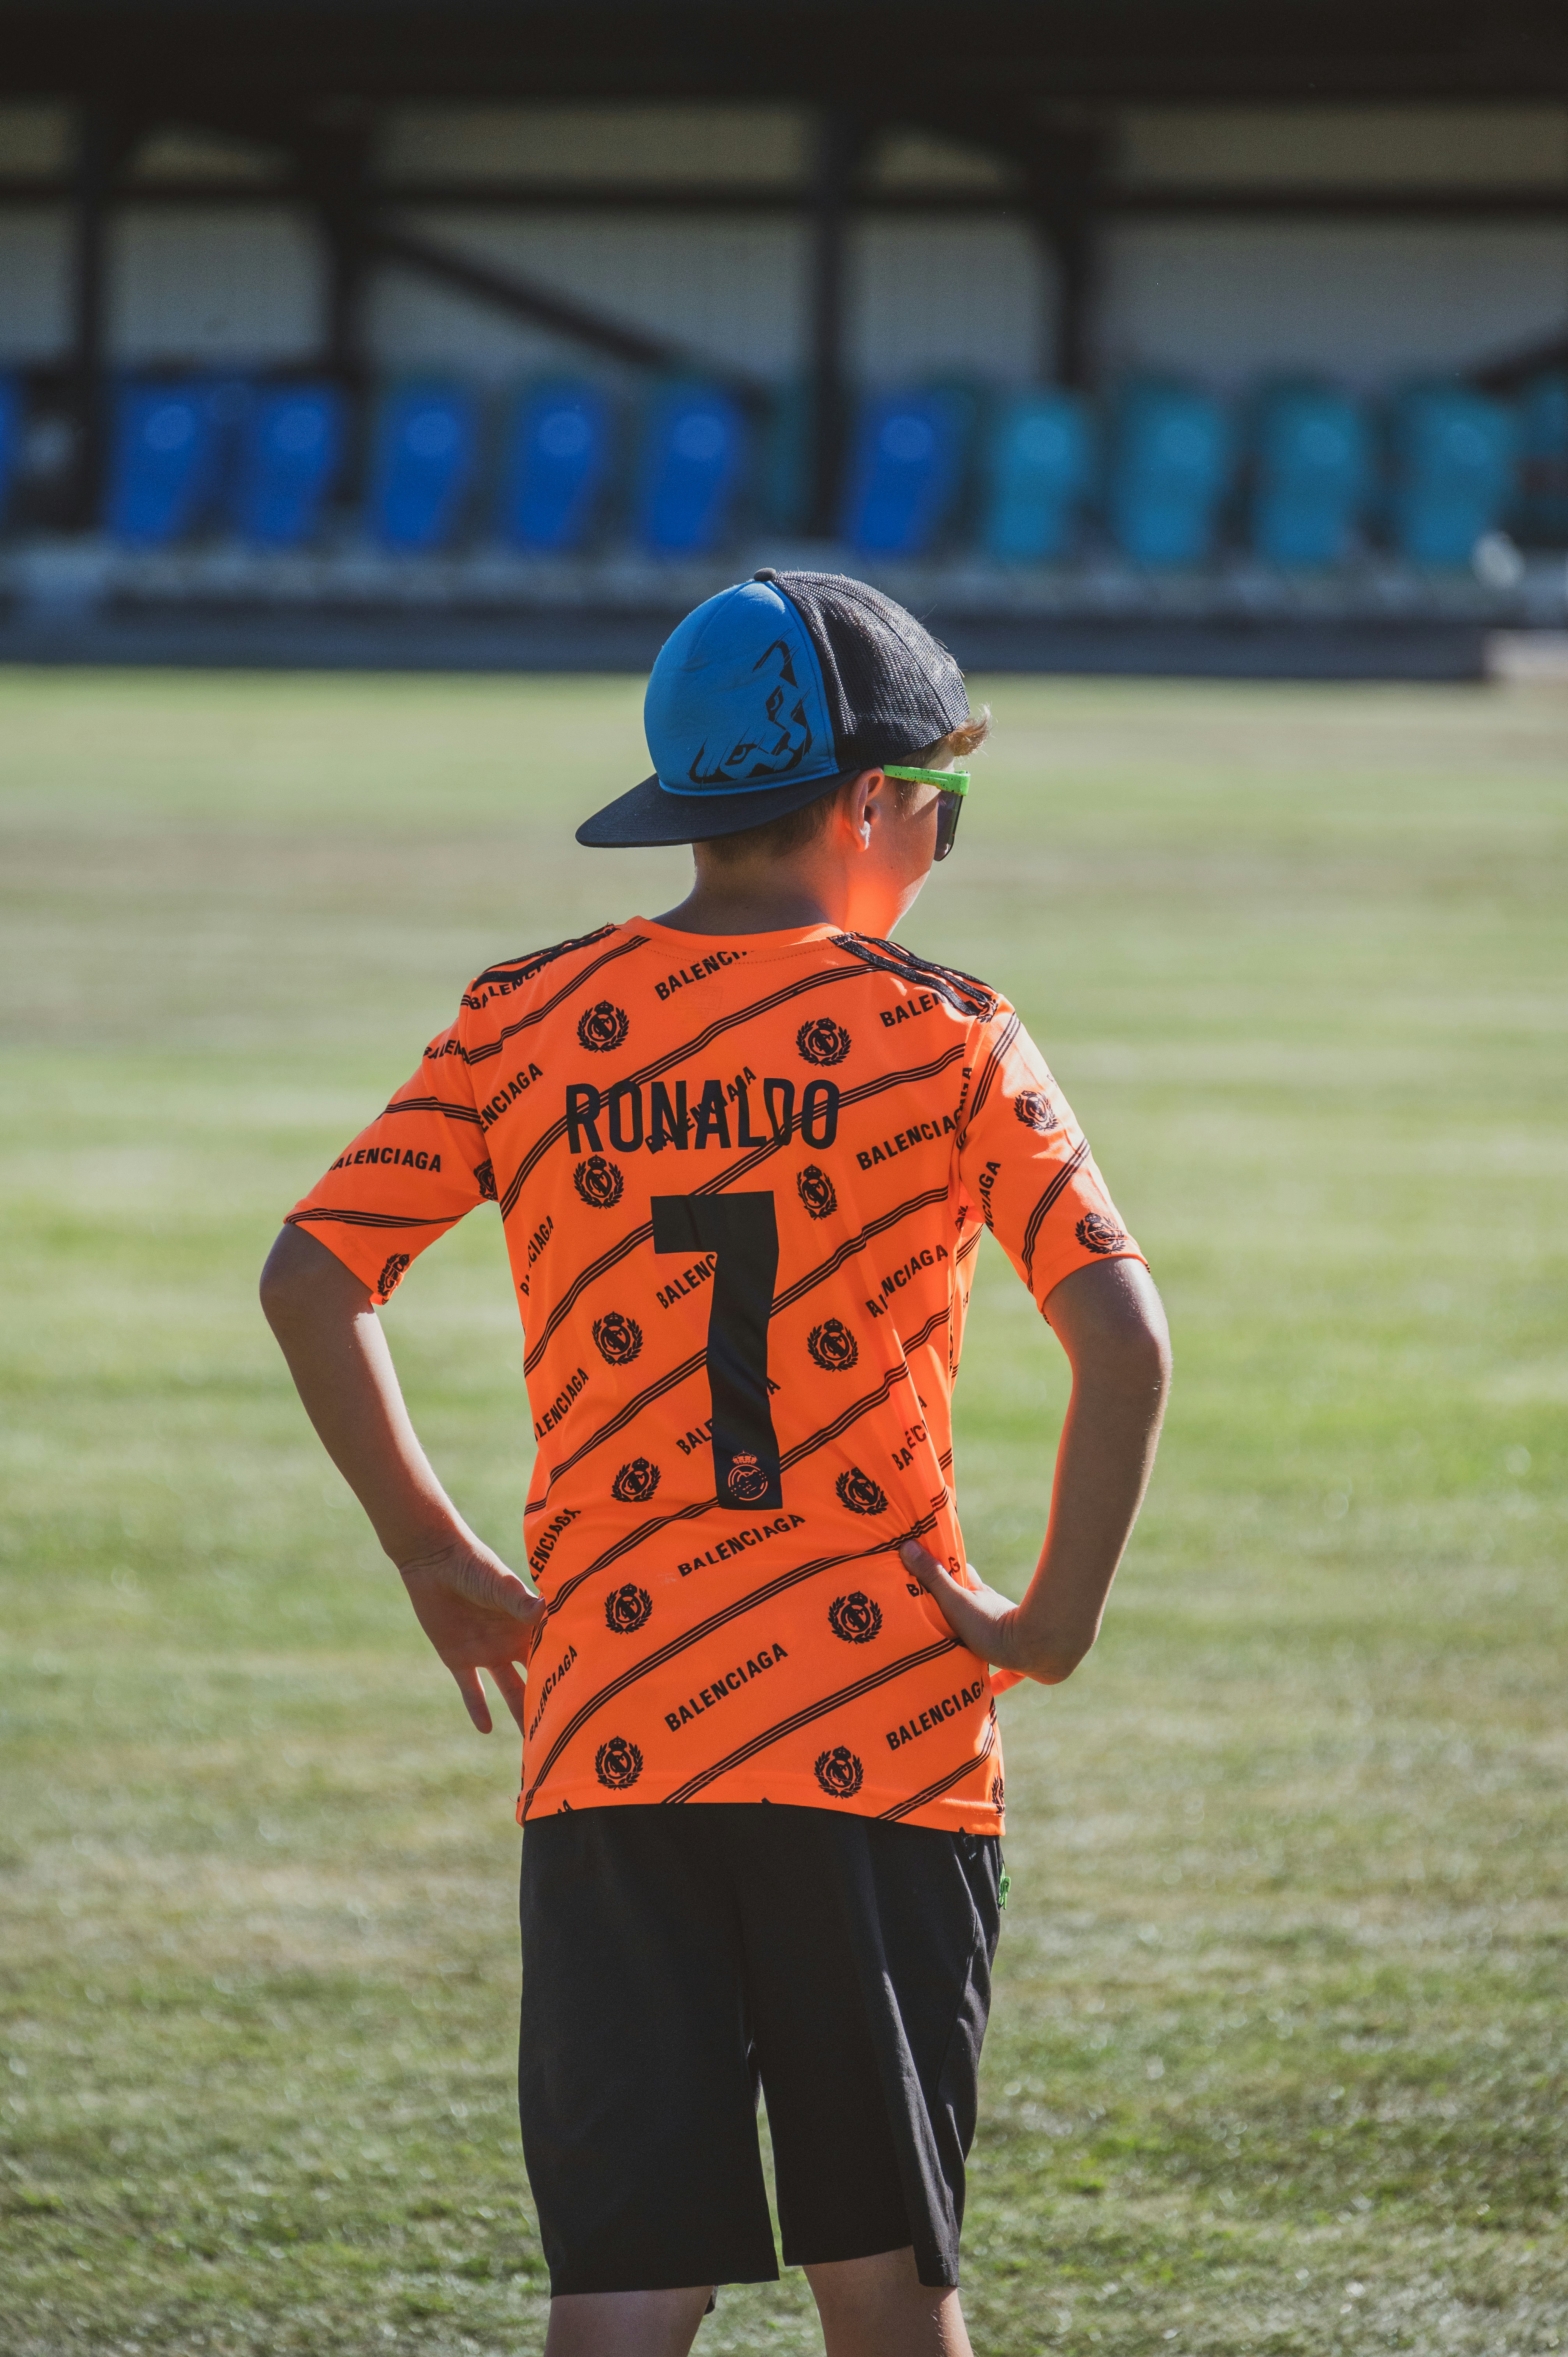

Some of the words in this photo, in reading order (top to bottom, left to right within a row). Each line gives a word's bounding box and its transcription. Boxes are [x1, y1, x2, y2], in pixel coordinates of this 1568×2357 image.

[566, 1077, 840, 1154] RONALDO
[328, 1147, 441, 1173] ALENCIAGA
[650, 1190, 783, 1511] 7
[534, 1368, 589, 1442] LENCIAGA
[677, 1514, 806, 1577] BALENCIAGA
[529, 1645, 577, 1742] BALENCIAGA
[660, 1643, 788, 1728] BALENCIAGA
